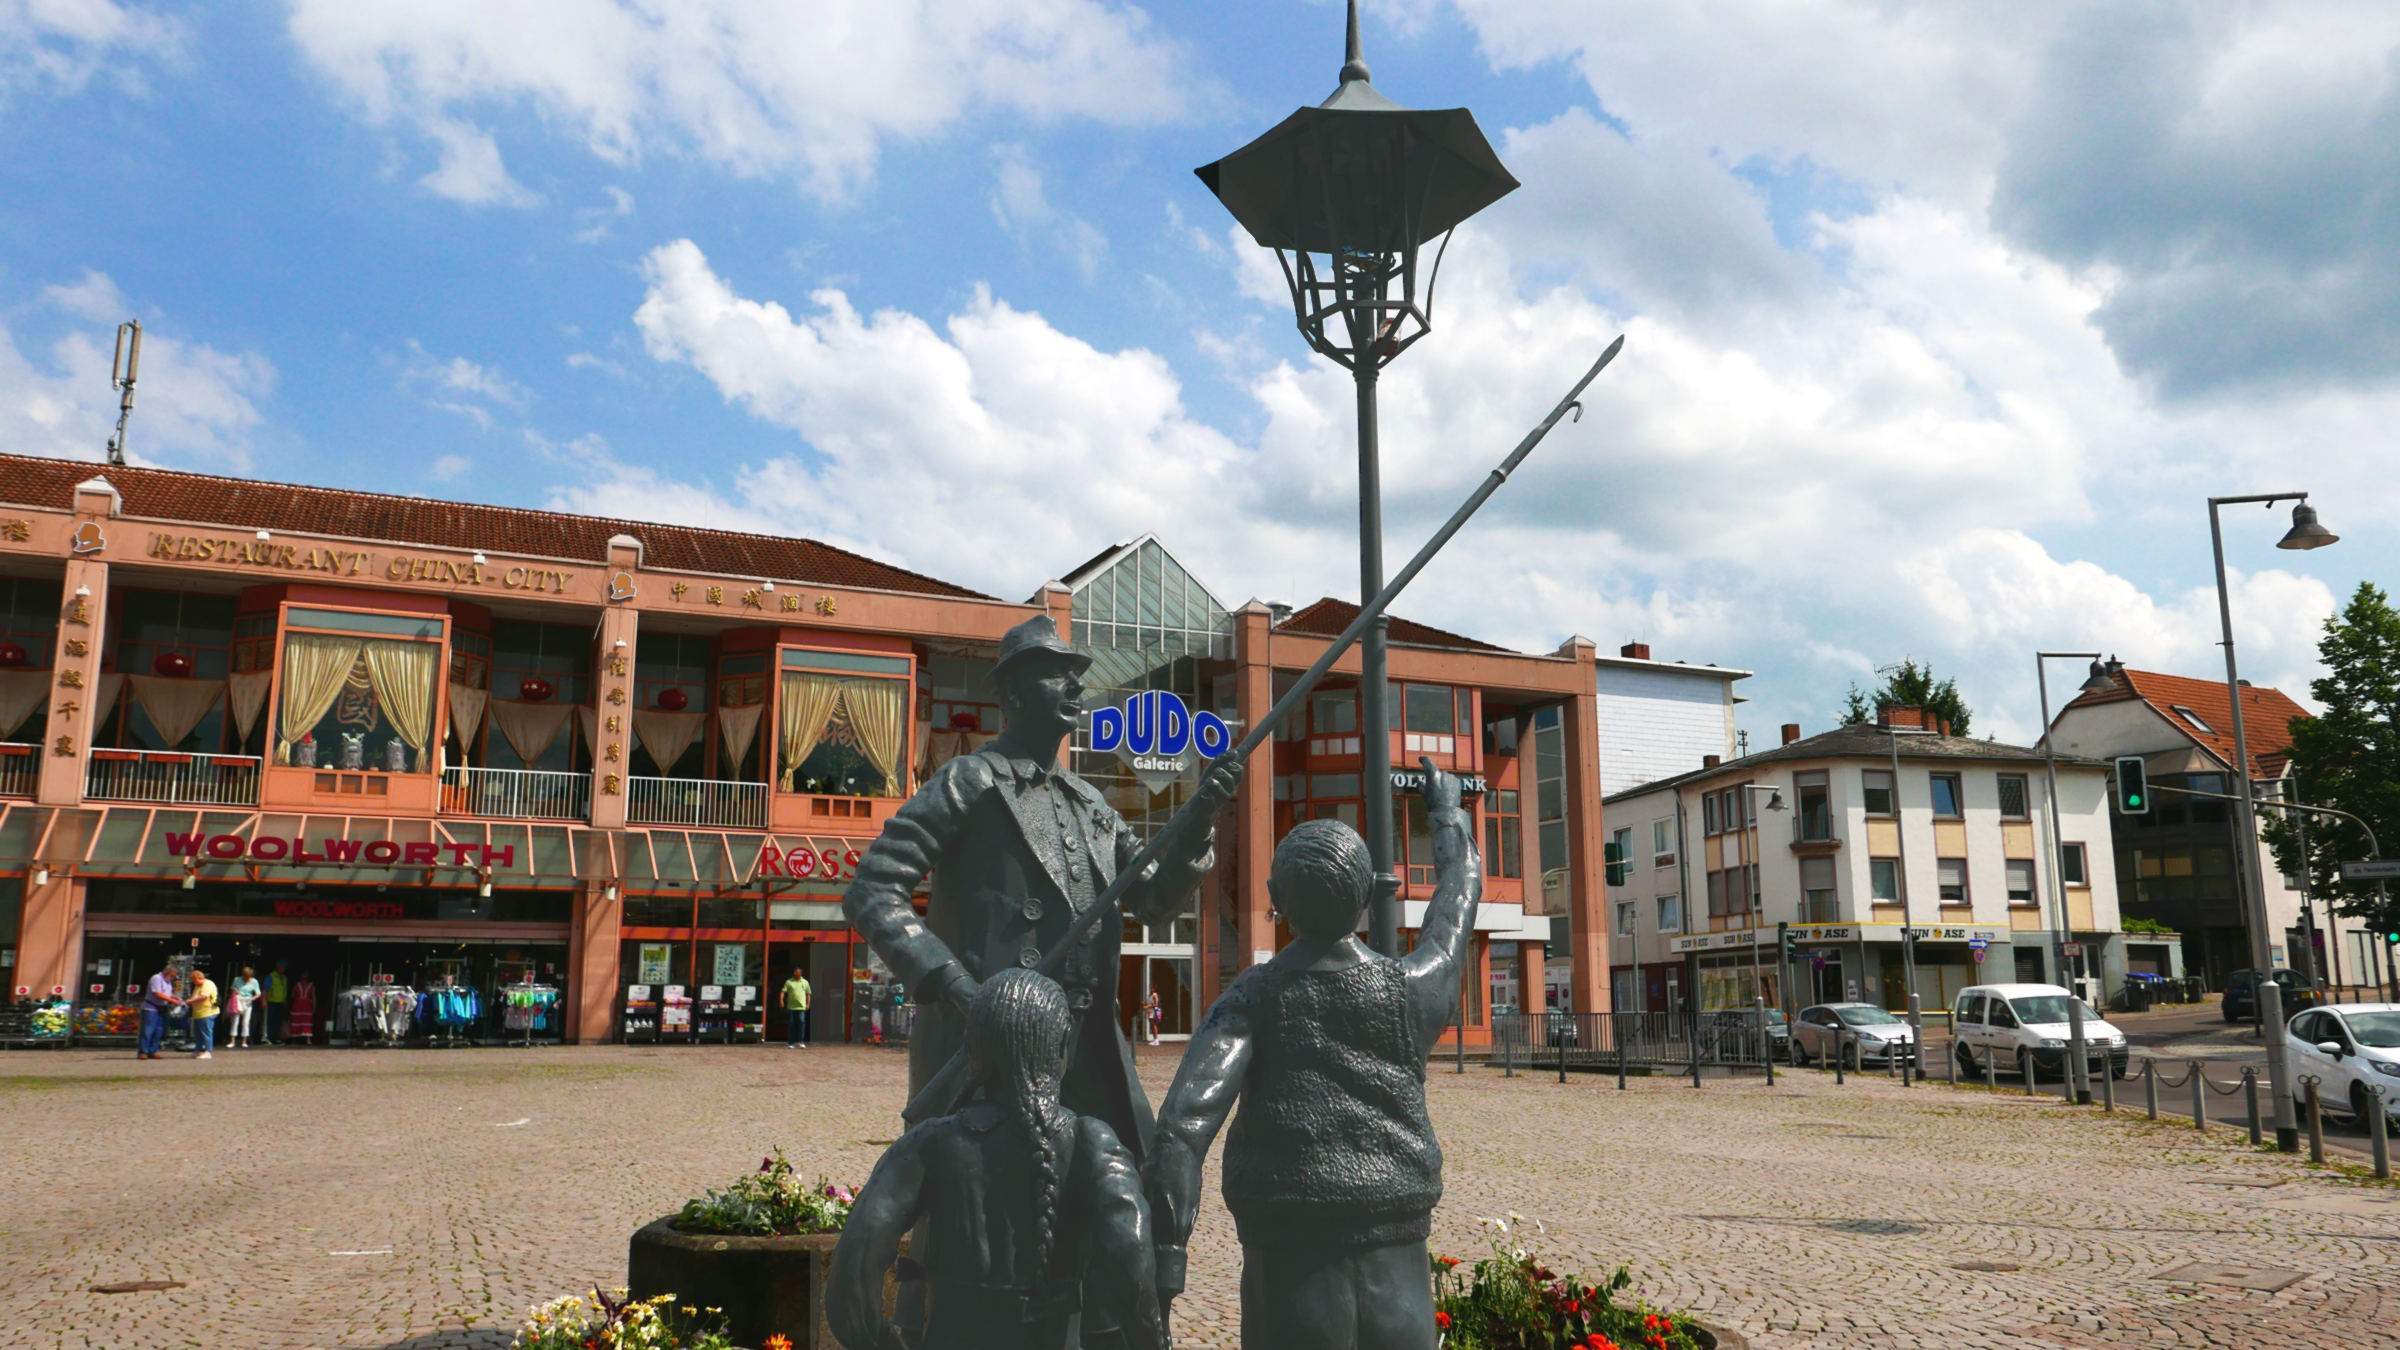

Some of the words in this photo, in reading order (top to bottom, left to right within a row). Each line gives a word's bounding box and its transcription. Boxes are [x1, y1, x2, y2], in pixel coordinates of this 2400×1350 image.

[152, 534, 367, 575] RESTAURANT
[503, 567, 573, 594] CITY
[1091, 690, 1231, 759] DUDO
[1133, 757, 1184, 771] Galerie
[165, 832, 514, 868] WOOLWORTH
[274, 901, 404, 917] WOOLWORTH
